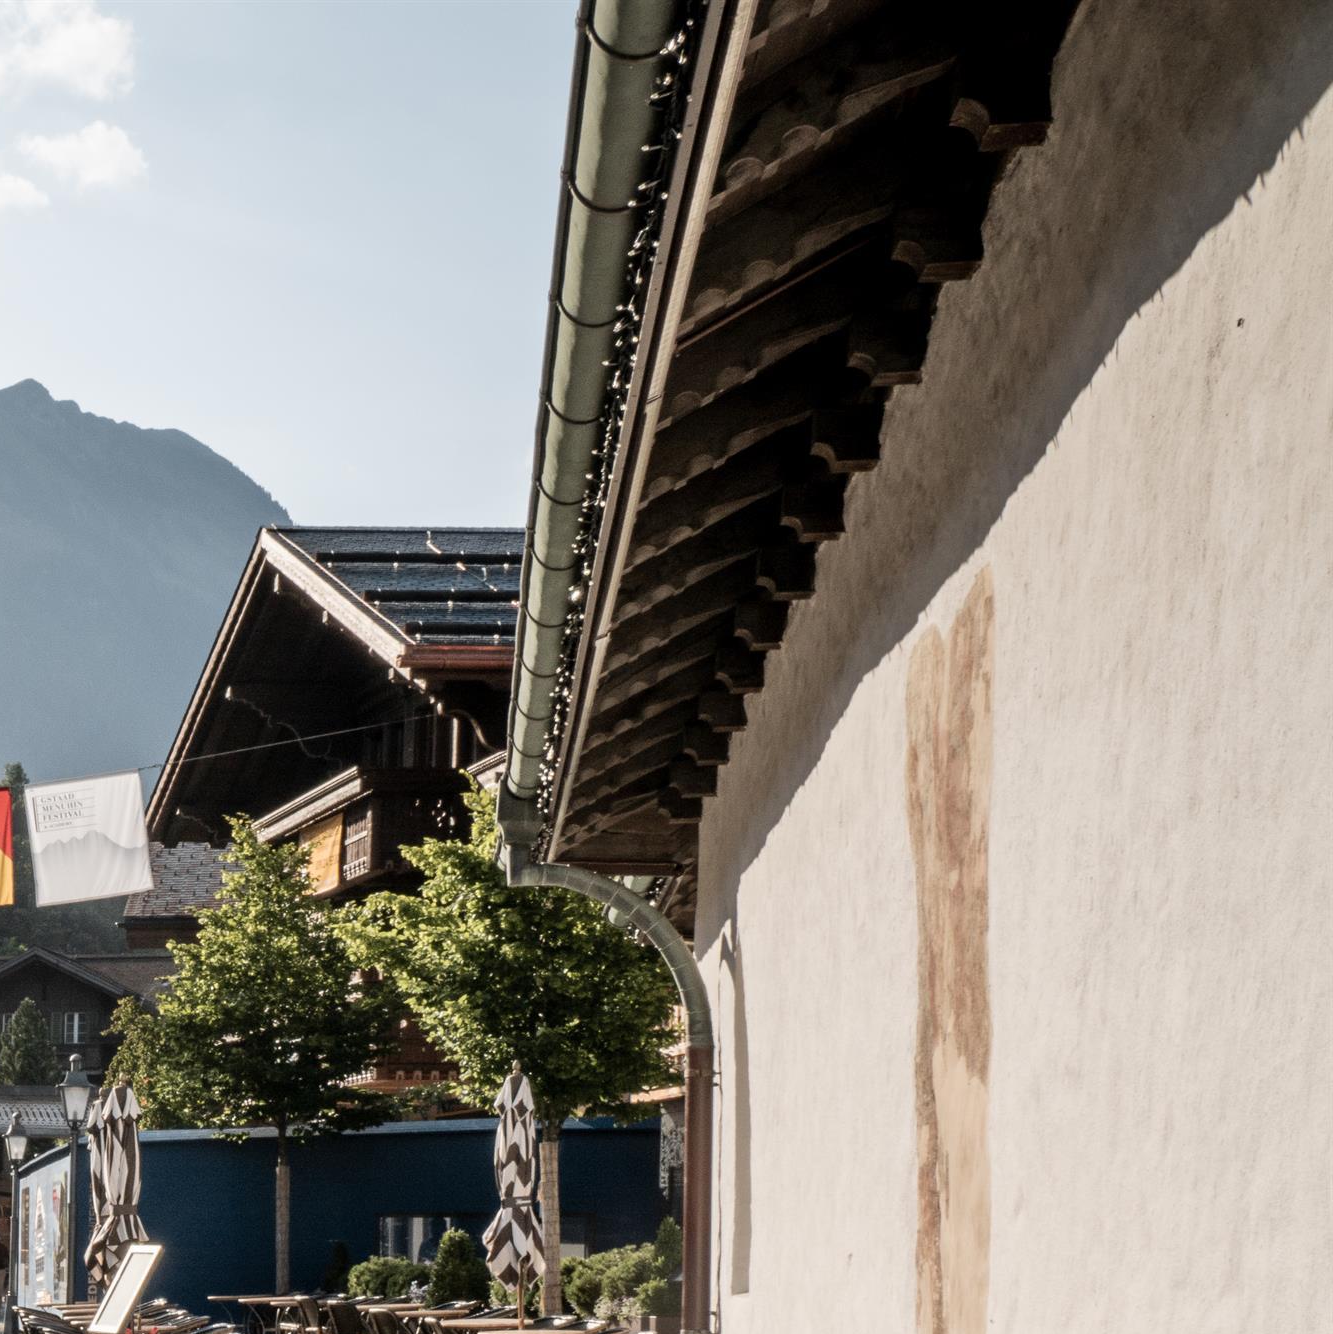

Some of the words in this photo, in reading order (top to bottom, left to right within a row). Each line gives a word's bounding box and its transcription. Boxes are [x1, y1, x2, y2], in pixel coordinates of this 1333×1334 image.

[41, 793, 75, 803] GSTAAD
[42, 801, 83, 812] MENUHIN
[43, 810, 82, 821] FESTIVAL
